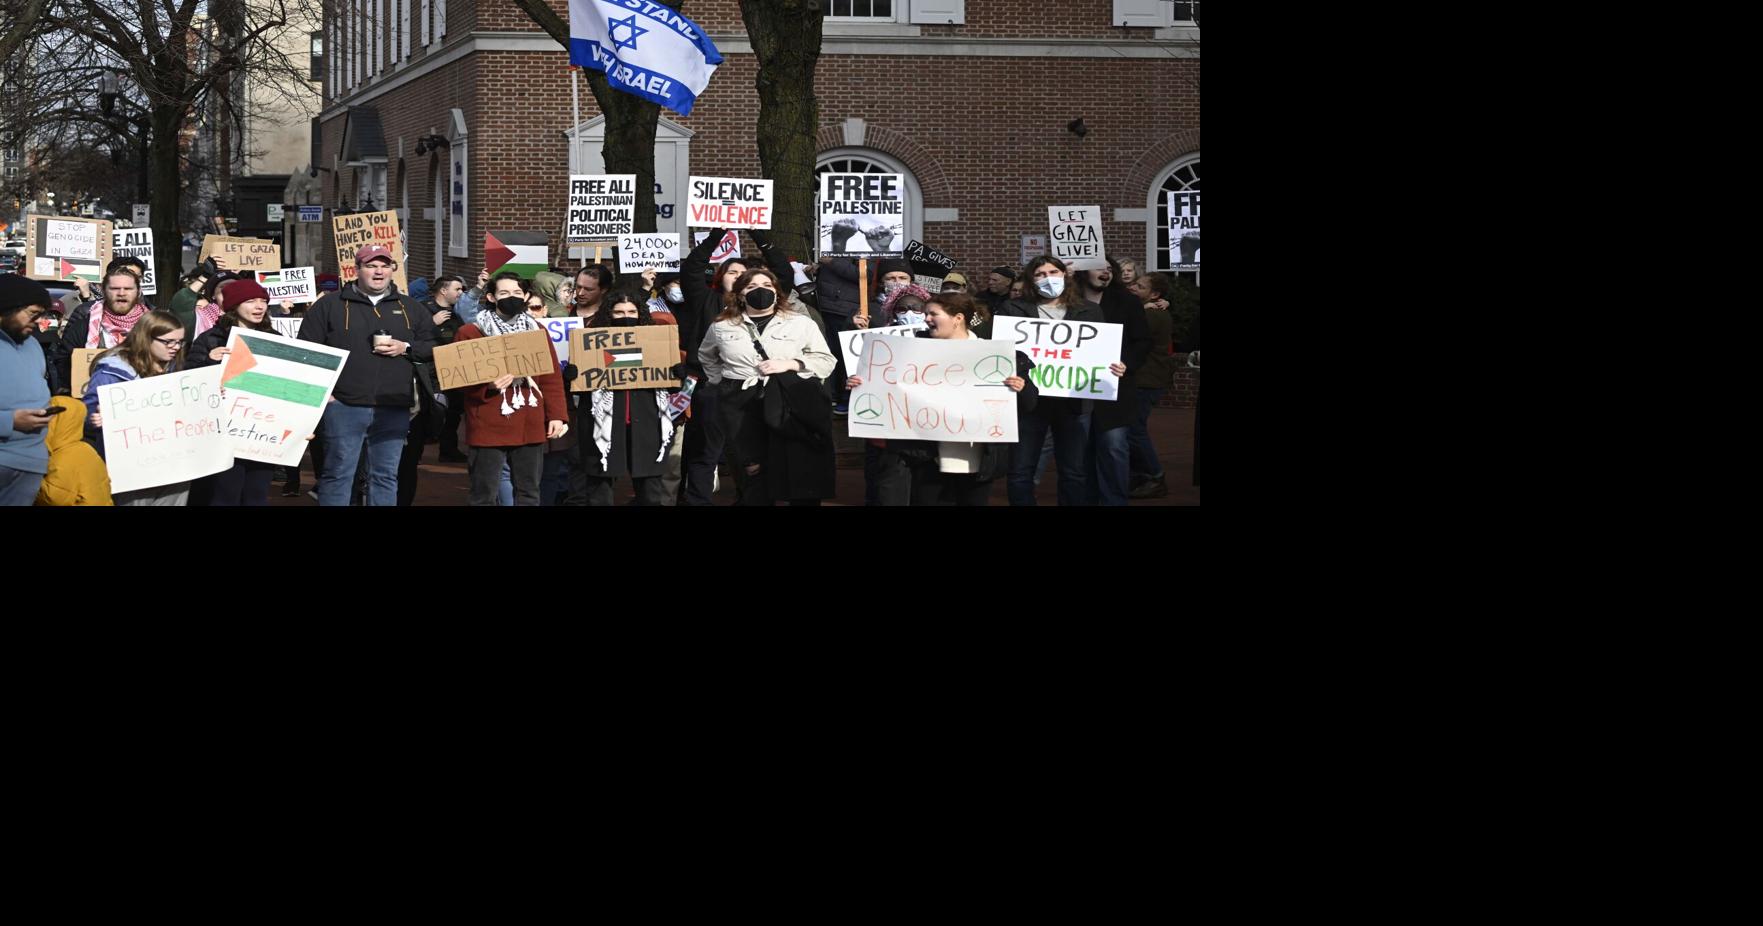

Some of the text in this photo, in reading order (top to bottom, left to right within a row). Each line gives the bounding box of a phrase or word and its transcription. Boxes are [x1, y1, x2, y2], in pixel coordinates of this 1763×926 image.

[612, 62, 671, 99] ISRAEL
[572, 179, 633, 194] FREE ALL
[694, 180, 764, 202] SILENCE
[828, 175, 897, 200] FREE
[570, 195, 633, 206] PALESTINIAN
[823, 201, 902, 214] PALESTINE
[570, 208, 632, 222] POLITICAL
[691, 203, 768, 225] VIOLENCE
[1058, 210, 1087, 221] LET
[58, 223, 86, 231] STOP
[335, 213, 388, 232] LAND YOU
[569, 223, 631, 235] PRISONERS
[48, 232, 95, 243] GENOCIDE
[125, 232, 151, 246] ALL
[336, 232, 358, 247] HAVE
[358, 229, 372, 241] TO
[374, 226, 396, 239] KILL
[1053, 225, 1098, 242] GAZA
[70, 247, 92, 255] GAZA
[225, 244, 275, 253] LET GAZA
[624, 238, 678, 251] 24,000+
[1057, 244, 1098, 256] LIVE!
[239, 256, 263, 265] LIVE
[908, 241, 924, 256] PA
[929, 251, 955, 270] GIVES
[645, 260, 664, 268] MANY
[285, 269, 307, 280] FREE
[267, 284, 309, 297] ALESTINE!
[583, 330, 635, 351] FREE
[1014, 320, 1098, 348] STOP
[456, 336, 516, 359] FREE
[1031, 348, 1072, 359] THE
[440, 352, 548, 387] PALESTINE
[868, 340, 968, 386] Peace
[1030, 364, 1106, 393] NOCIDE
[109, 386, 173, 419] Peace
[230, 396, 275, 422] Free
[113, 425, 164, 449] The
